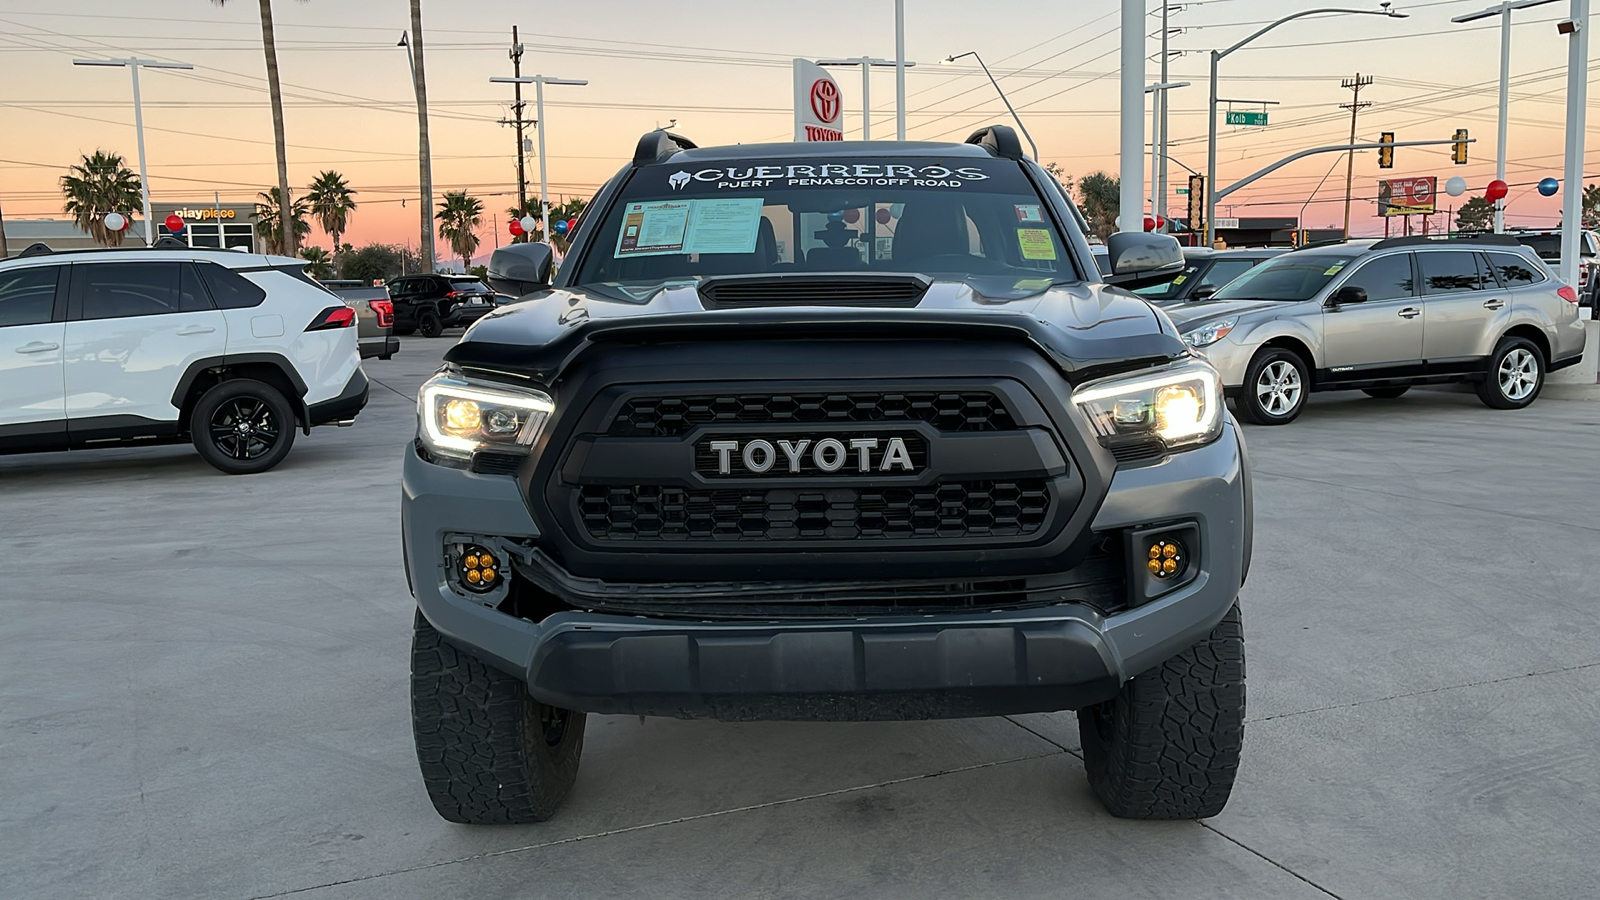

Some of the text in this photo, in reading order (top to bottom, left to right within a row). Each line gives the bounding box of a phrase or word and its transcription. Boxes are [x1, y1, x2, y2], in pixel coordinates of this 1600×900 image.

[1231, 113, 1246, 124] Kolb
[805, 125, 843, 142] TOYOTA
[692, 163, 991, 182] GUERREROS
[876, 178, 910, 186] OFF
[913, 179, 962, 188] ROAD
[710, 438, 914, 474] TOYOTA
